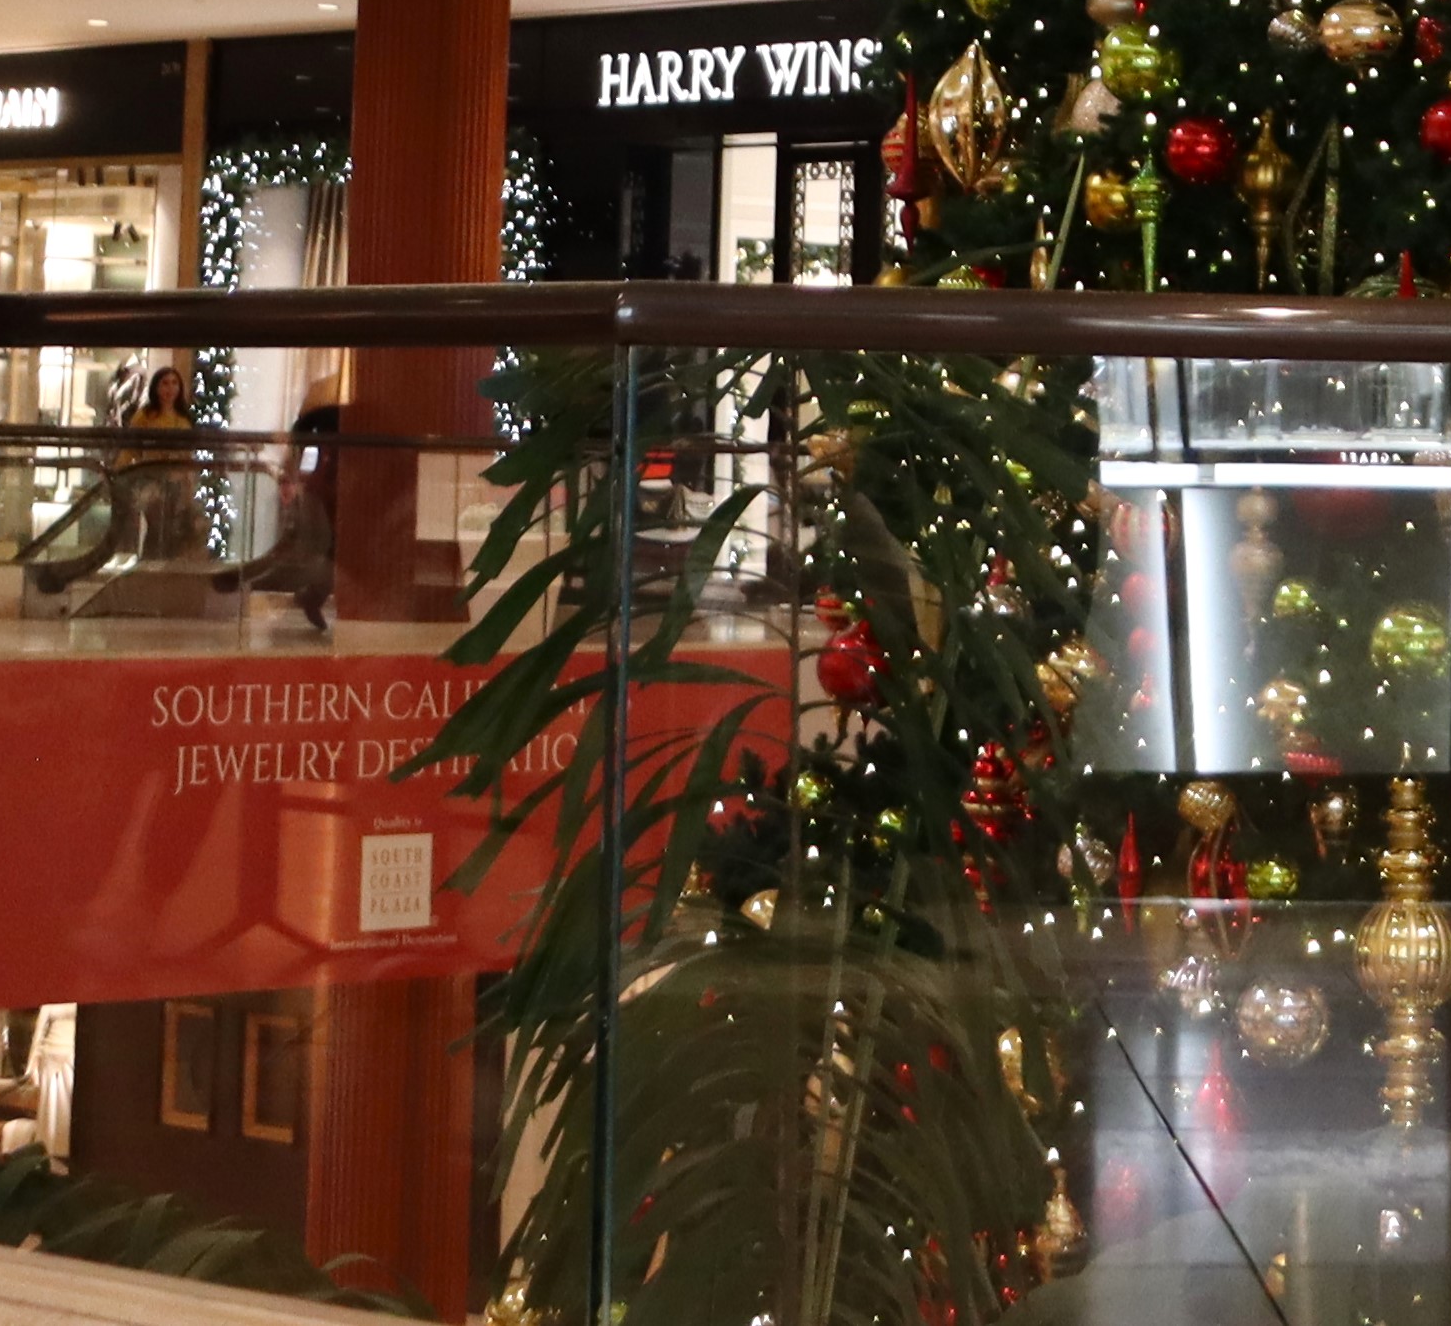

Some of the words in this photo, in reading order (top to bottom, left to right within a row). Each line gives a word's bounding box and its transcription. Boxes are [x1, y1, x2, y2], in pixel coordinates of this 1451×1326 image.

[597, 45, 747, 107] HARRY
[755, 37, 883, 98] WINS
[151, 682, 372, 728] SOUTHERN
[174, 740, 341, 796] JEWELRY
[371, 846, 424, 866] SOUTH
[369, 870, 421, 890] COAST
[369, 896, 421, 915] PLAZA
